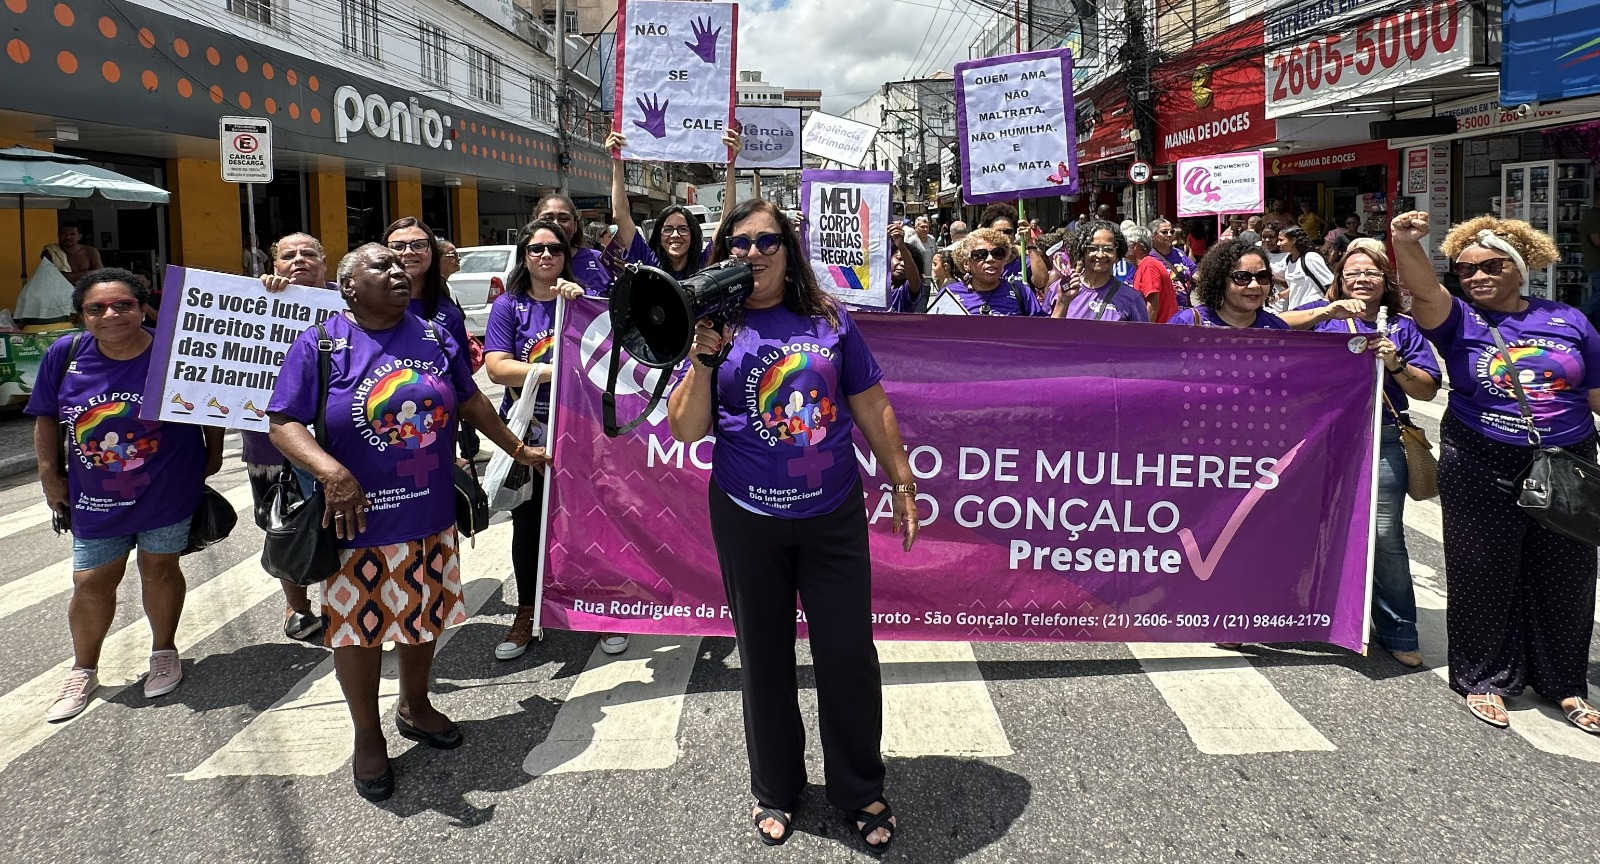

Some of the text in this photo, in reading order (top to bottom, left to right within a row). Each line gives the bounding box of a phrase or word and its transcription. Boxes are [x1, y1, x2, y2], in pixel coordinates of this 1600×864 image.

[635, 23, 668, 36] NÃO
[1272, 0, 1459, 102] 2605-5000
[668, 70, 688, 80] SE
[975, 70, 1047, 86] QUEM AMA
[1004, 89, 1029, 101] NÃO
[979, 105, 1046, 122] MALTRATA.
[1479, 102, 1489, 112] EM
[683, 118, 723, 131] CALE
[743, 124, 794, 137] lência
[816, 121, 861, 141] Violência
[1164, 111, 1250, 150] MANIA DE DOCES
[1456, 114, 1490, 131] 5-5000
[807, 130, 863, 153] Patrimonial
[971, 123, 1058, 143] NÃO HUMILHA.
[744, 139, 783, 152] ísica
[1013, 143, 1021, 152] E
[982, 160, 1052, 174] NÃO MATA
[1213, 162, 1250, 170] MOVIMENTO
[1298, 152, 1356, 168] MANIA DE DOCES
[1222, 177, 1256, 185] MULHERES
[820, 187, 861, 215] MEU
[820, 215, 860, 233] CORPO
[820, 232, 862, 249] MINHAS
[821, 248, 864, 267] REGRAS
[186, 287, 214, 309] Se
[218, 296, 268, 316] você
[271, 298, 311, 323] luta
[182, 311, 265, 341] Direitos
[177, 337, 286, 367] das Mulhe
[521, 329, 548, 362] ULHER, EU
[173, 360, 278, 391] Faz barulh
[375, 363, 393, 378] EU
[393, 358, 446, 377] POSSO!
[351, 375, 379, 429] MULHER,
[745, 342, 836, 447] SOU MULHER, EU POSSO!
[74, 448, 93, 469] SOU
[88, 393, 107, 407] EU
[361, 428, 389, 452] SOU
[958, 446, 1020, 483] DE
[1035, 449, 1280, 491] MULHERES
[374, 488, 430, 504] Internacional
[378, 487, 406, 497] Março
[749, 488, 823, 503] Dia Internacional
[756, 487, 767, 495] de
[769, 488, 798, 496] Março
[372, 502, 401, 512] Mulher
[863, 483, 1180, 541] ÃO GONÇALO
[1009, 539, 1182, 574] Presente
[573, 599, 605, 614] Rua
[610, 600, 692, 621] Rodrigues
[695, 603, 715, 619] da
[871, 611, 911, 625] aroto
[924, 611, 952, 625] São
[956, 612, 1019, 629] Gonçalo
[1022, 613, 1099, 627] Telefones:
[1102, 613, 1130, 629] (21)
[1176, 614, 1210, 627] 5003
[1223, 614, 1250, 630] (21)
[1253, 613, 1331, 628] 98464-2179
